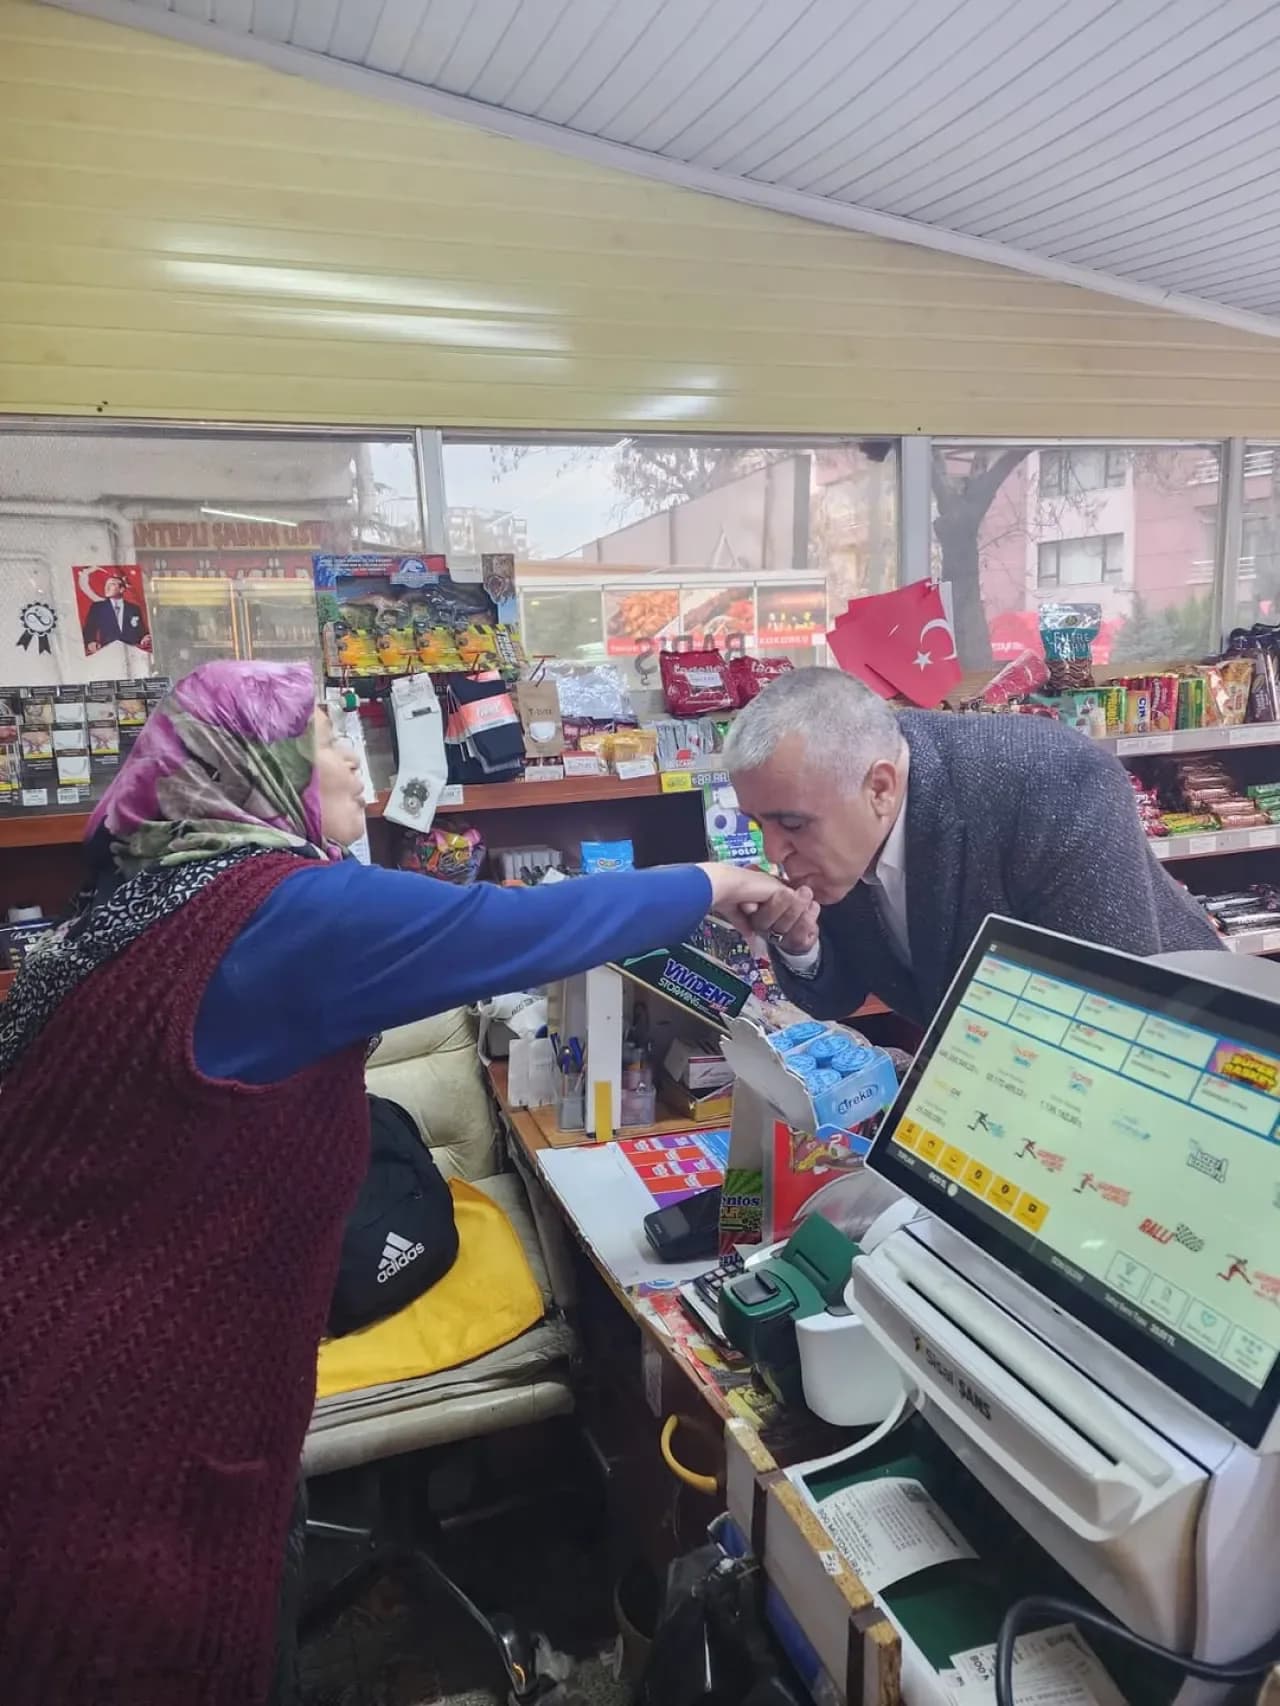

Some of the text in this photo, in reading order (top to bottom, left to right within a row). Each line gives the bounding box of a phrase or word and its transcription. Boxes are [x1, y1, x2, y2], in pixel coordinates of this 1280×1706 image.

[731, 847, 757, 857] POLO
[663, 958, 737, 1007] VIVIDENT
[720, 1194, 762, 1207] entos
[376, 1242, 425, 1283] adidas
